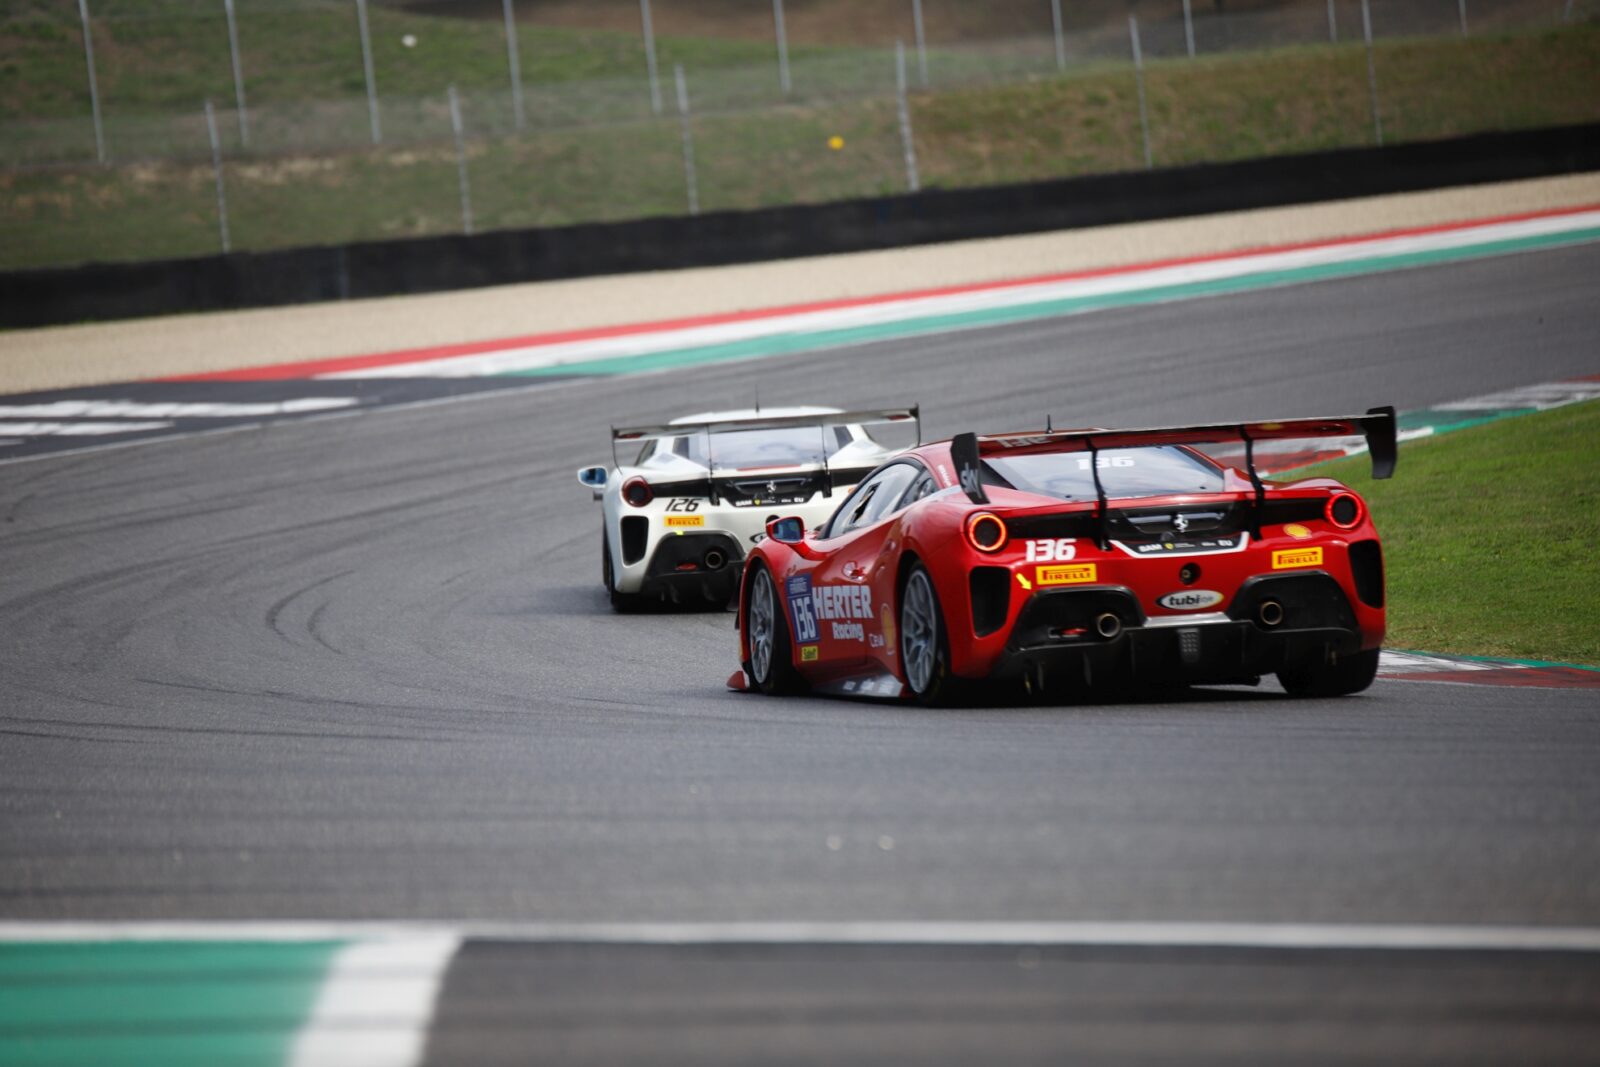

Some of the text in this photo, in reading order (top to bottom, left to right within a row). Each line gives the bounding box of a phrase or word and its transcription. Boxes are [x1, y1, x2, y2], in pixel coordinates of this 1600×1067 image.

[665, 498, 700, 512] 126
[667, 517, 701, 526] PIRELLI
[1025, 538, 1077, 562] 136
[1277, 550, 1318, 565] PIRELLI
[1042, 567, 1092, 581] PIRELLI
[812, 585, 874, 619] HERTER
[1169, 594, 1201, 606] tubi
[792, 596, 817, 641] 136
[832, 620, 864, 642] Racing
